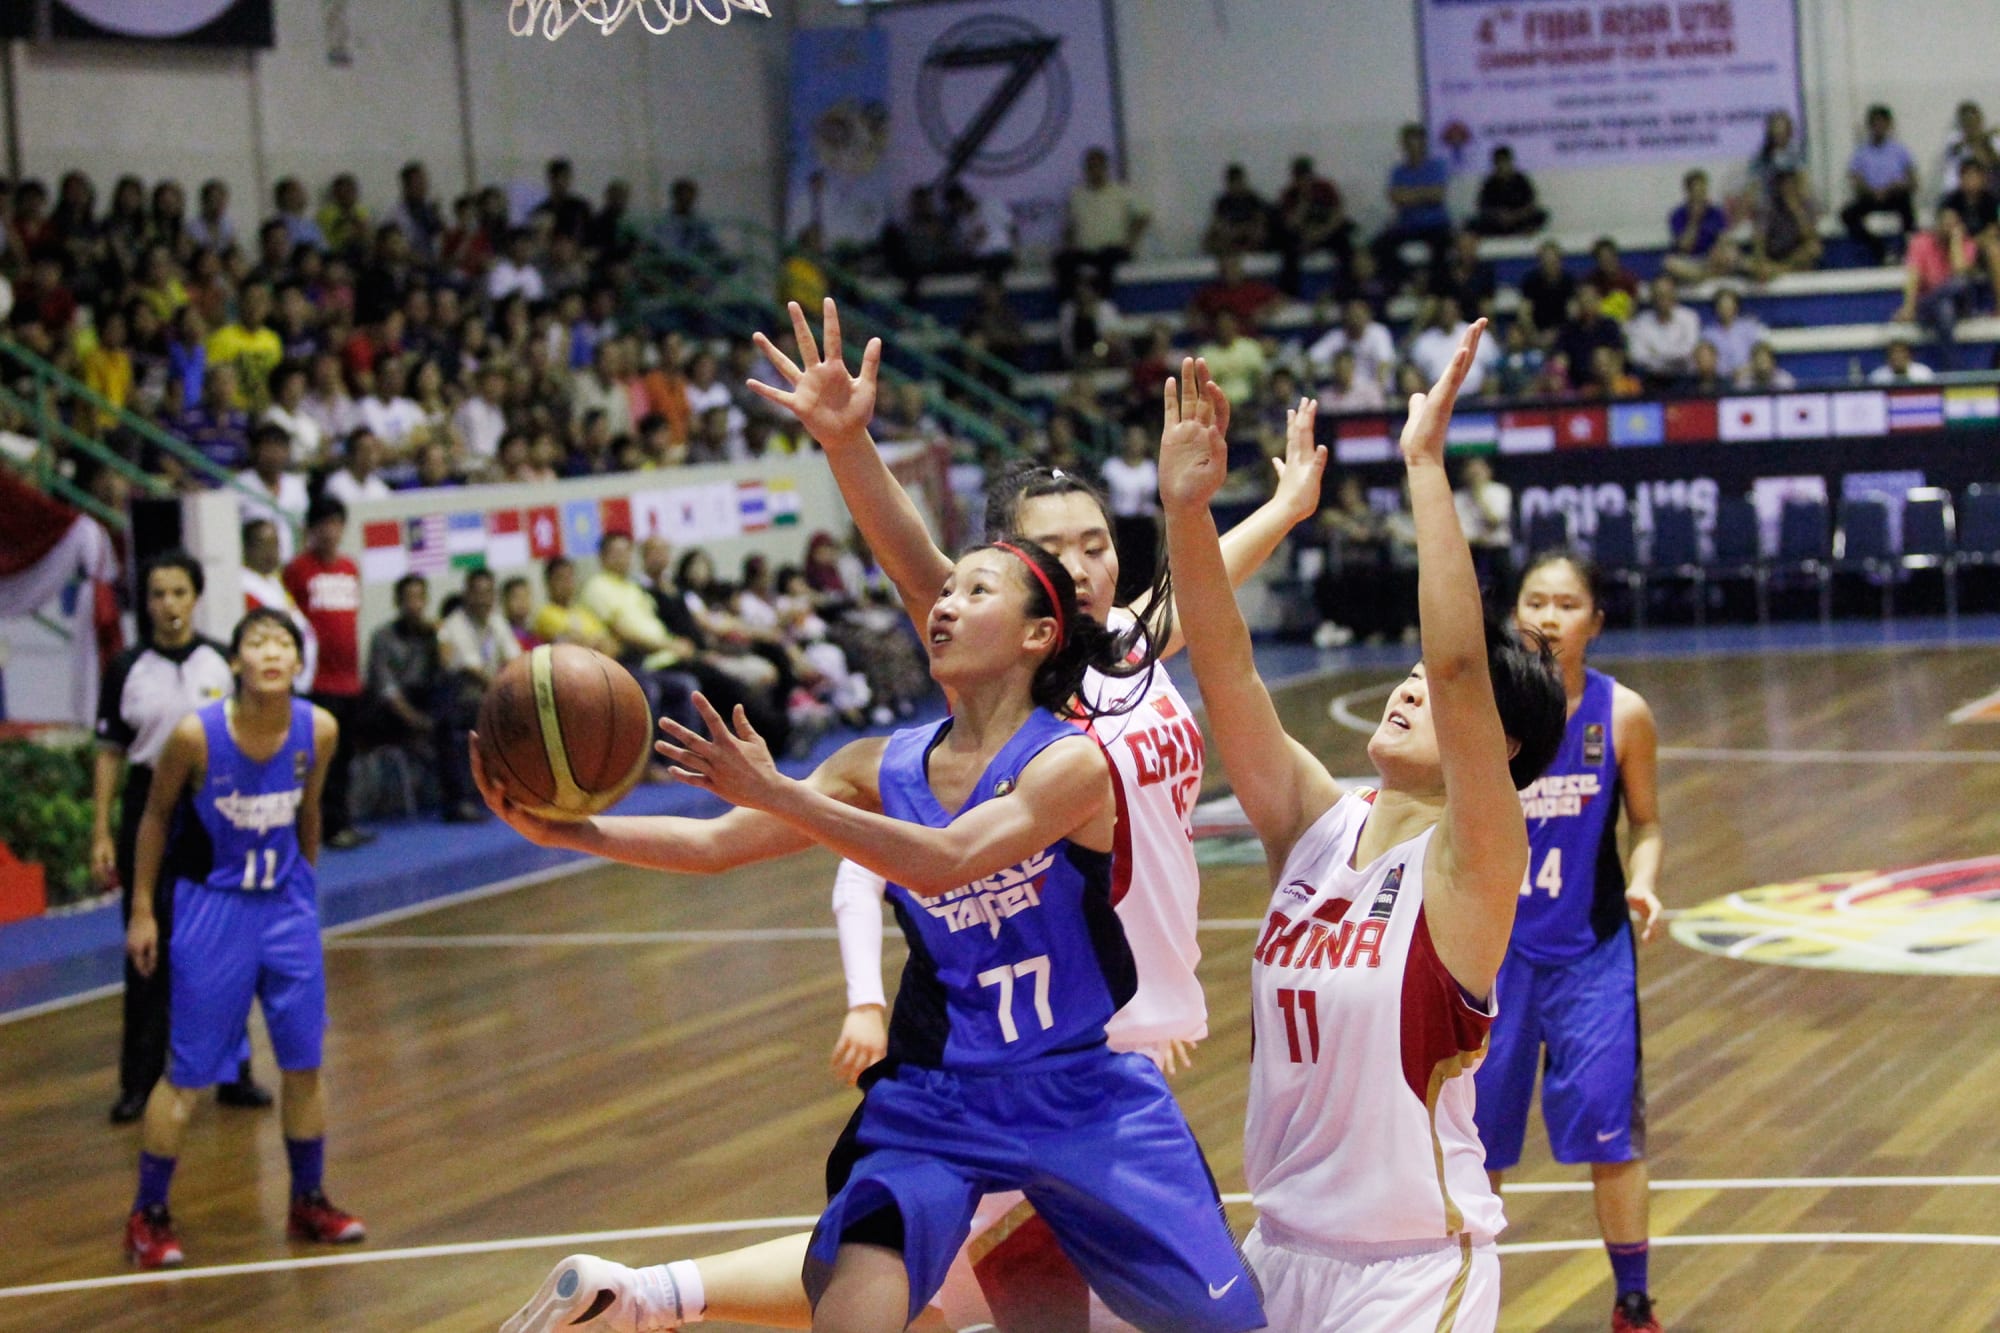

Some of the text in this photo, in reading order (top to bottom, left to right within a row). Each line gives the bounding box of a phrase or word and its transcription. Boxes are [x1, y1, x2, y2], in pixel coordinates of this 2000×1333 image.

[1124, 718, 1205, 788] CHIN
[240, 849, 277, 889] 11
[976, 954, 1055, 1043] 77
[1277, 987, 1320, 1064] 11
